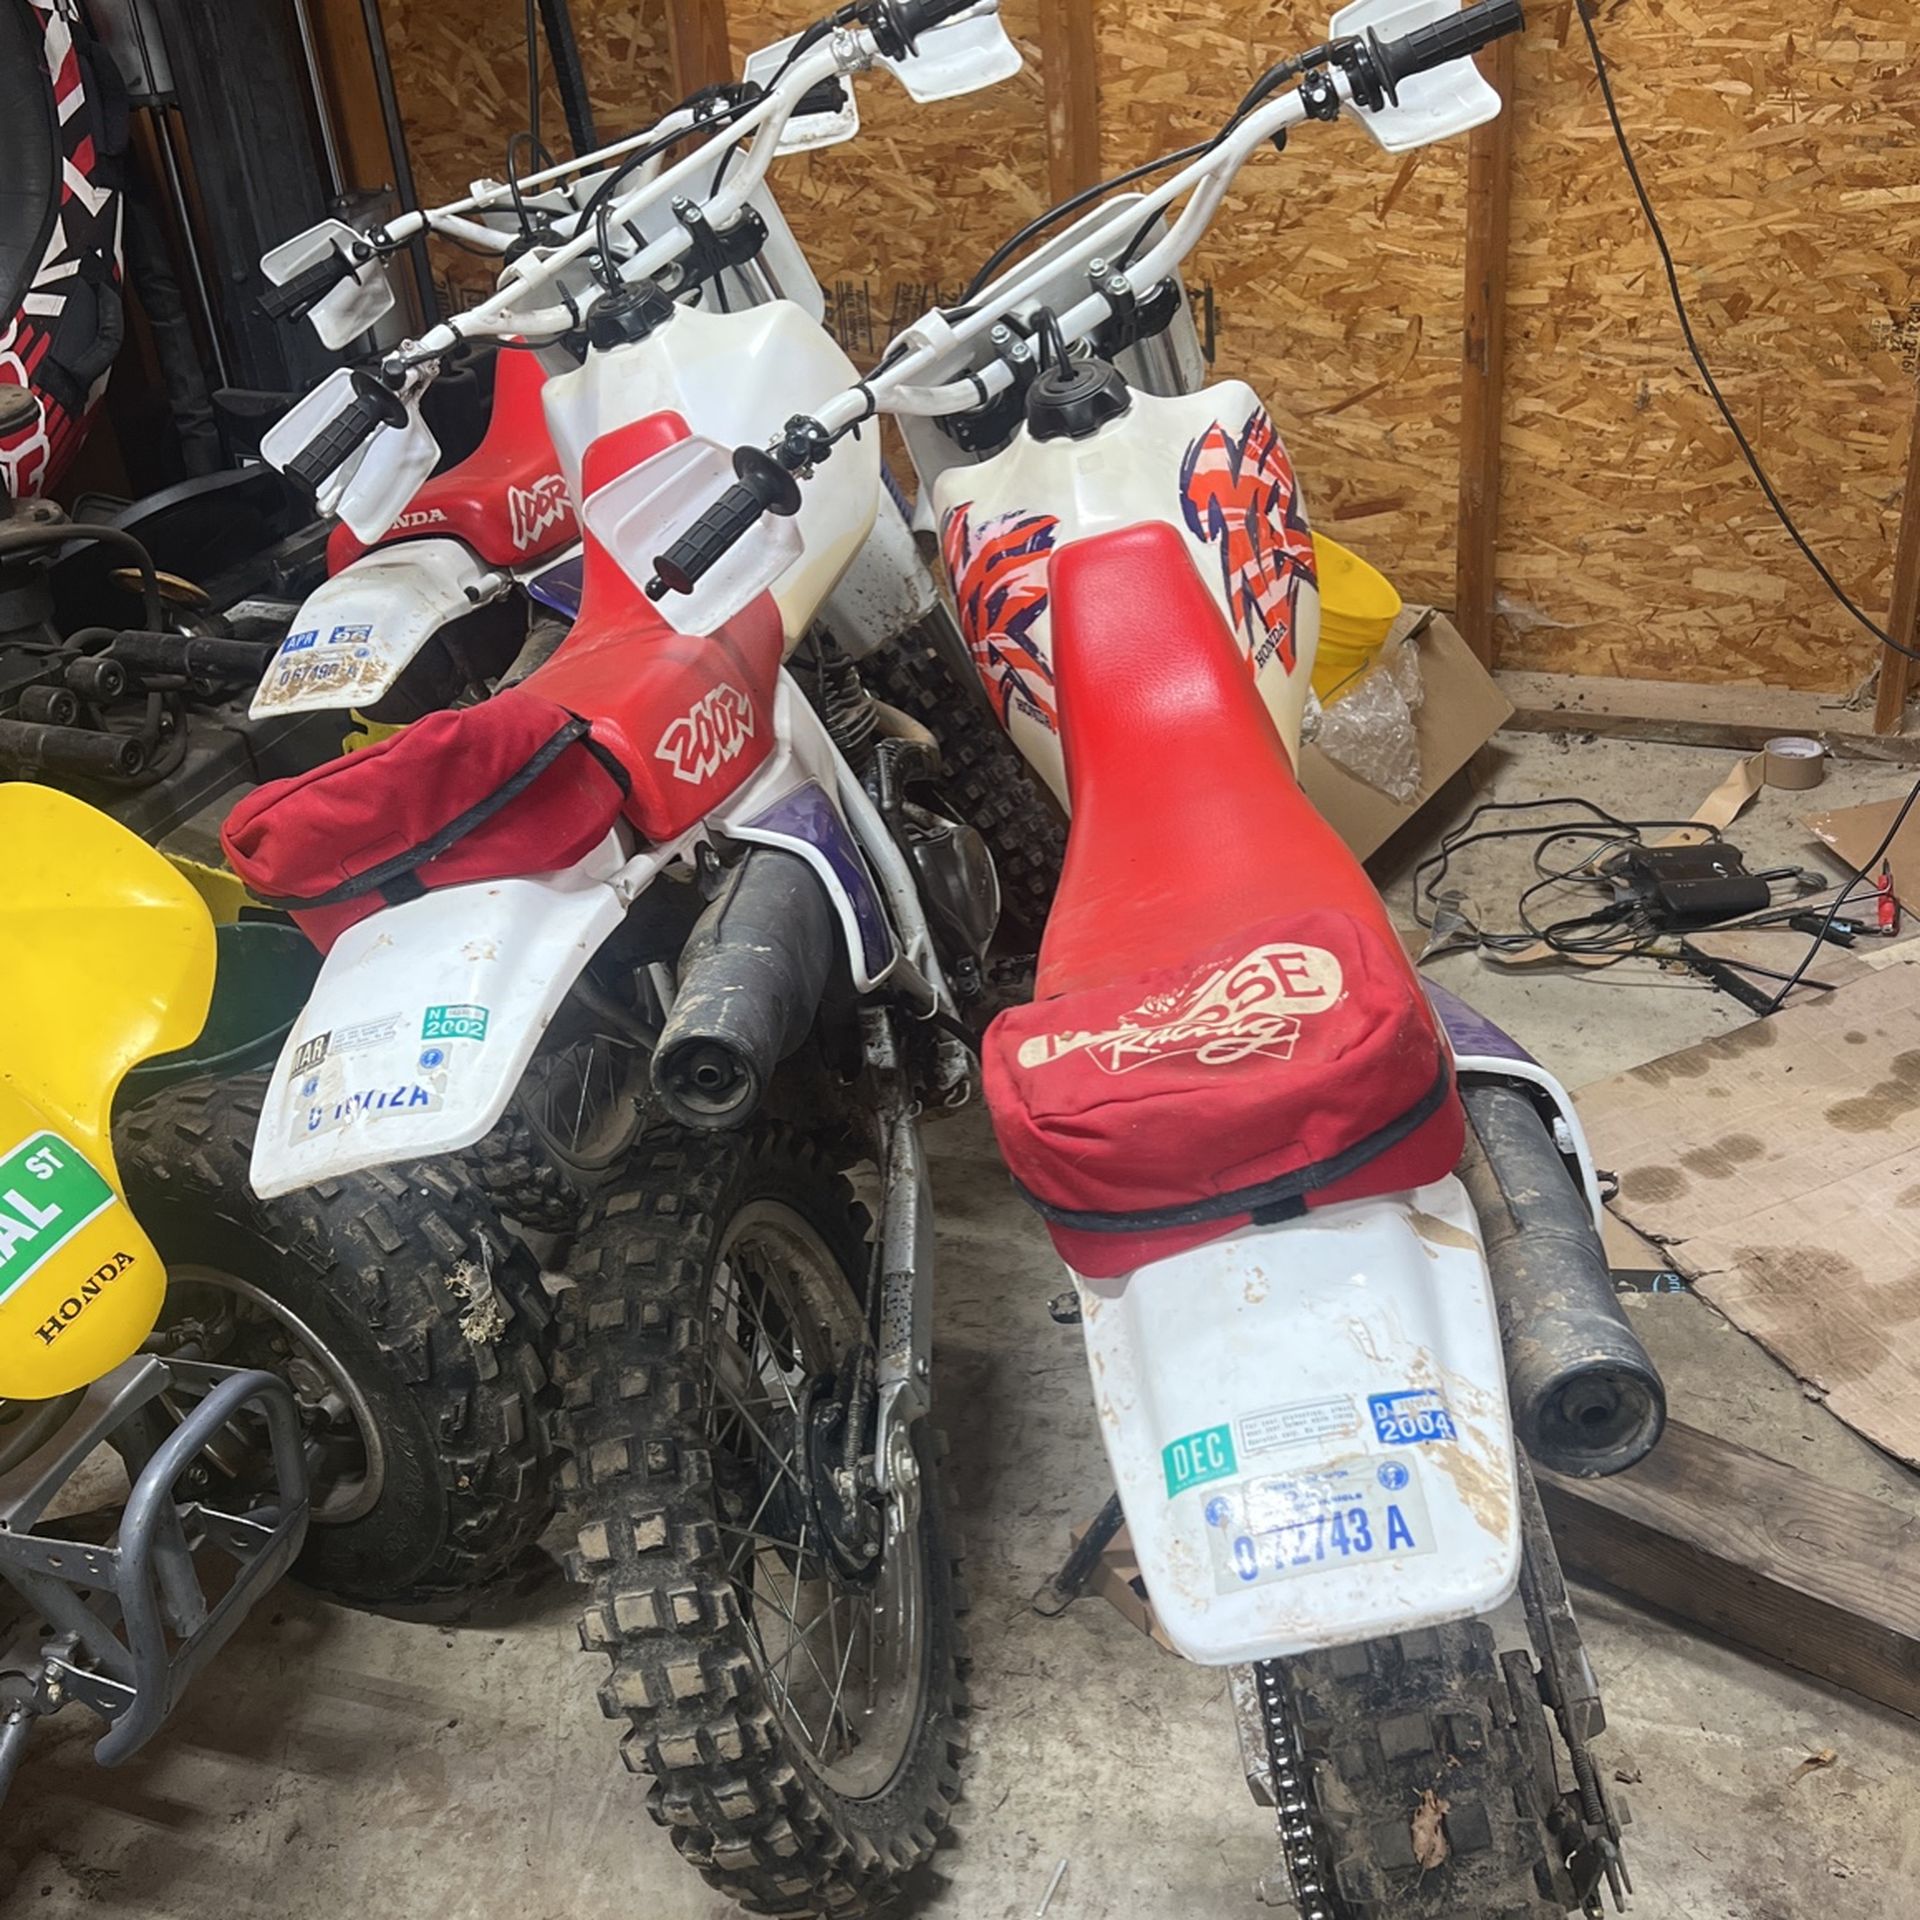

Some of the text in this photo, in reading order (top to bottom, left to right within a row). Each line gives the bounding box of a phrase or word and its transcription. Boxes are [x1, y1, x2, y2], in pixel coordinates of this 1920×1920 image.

[391, 507, 448, 530] NDA
[287, 632, 314, 650] APR
[1254, 620, 1287, 668] HONDA
[425, 1020, 485, 1038] 2002
[1100, 1015, 1299, 1070] Racing
[25, 1146, 65, 1181] ST
[0, 1188, 64, 1268] AL
[35, 1251, 135, 1345] HONDA
[1172, 1432, 1225, 1482] DEC
